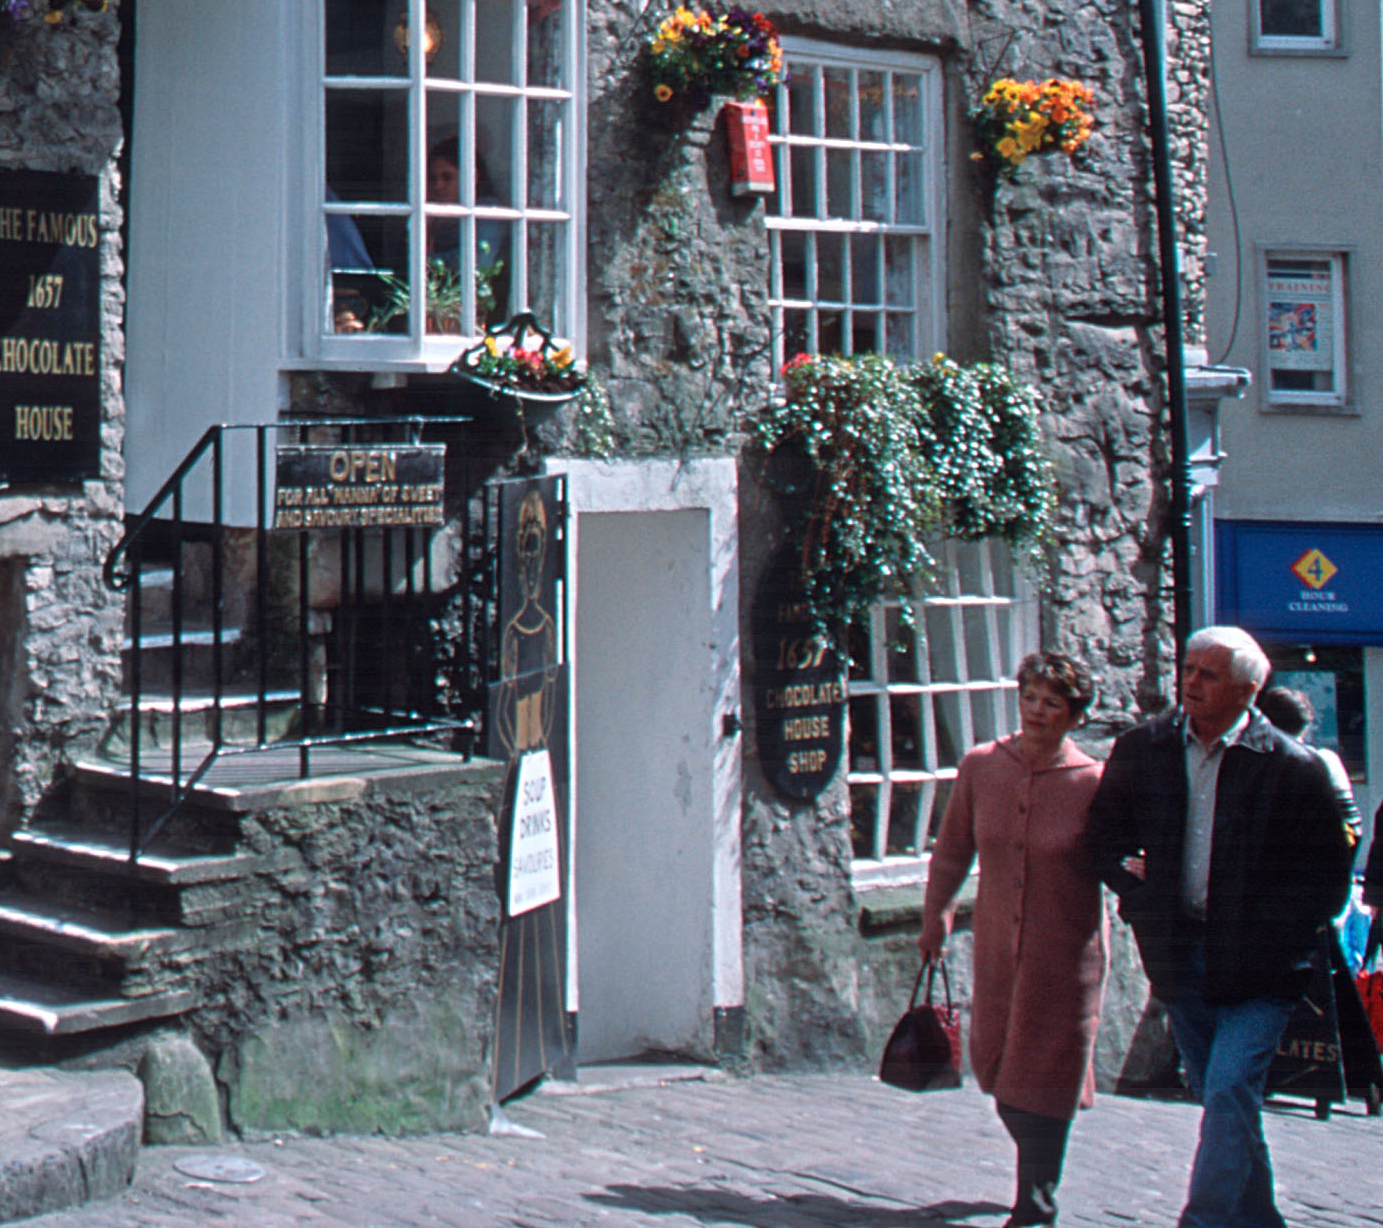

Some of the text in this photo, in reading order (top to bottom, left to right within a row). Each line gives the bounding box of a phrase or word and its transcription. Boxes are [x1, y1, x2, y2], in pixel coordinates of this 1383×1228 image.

[27, 210, 98, 248] FAMOUS
[26, 274, 63, 309] 1657
[15, 406, 73, 441] HOUSE
[330, 450, 397, 483] OPEN
[277, 487, 304, 506] FOR
[305, 486, 329, 505] ALL
[382, 485, 399, 504] OF
[401, 484, 442, 503] SWEET
[275, 509, 303, 529] AND
[304, 507, 359, 527] SAVOURY
[1307, 556, 1324, 582] 4
[1288, 602, 1349, 612] CLEANING
[767, 681, 843, 709] CHOCOLATE
[784, 716, 830, 741] HOUSE
[789, 750, 827, 774] SHOP
[523, 776, 546, 806] SOUP
[520, 809, 551, 839] DRINKS
[1277, 1040, 1338, 1062] LATES
